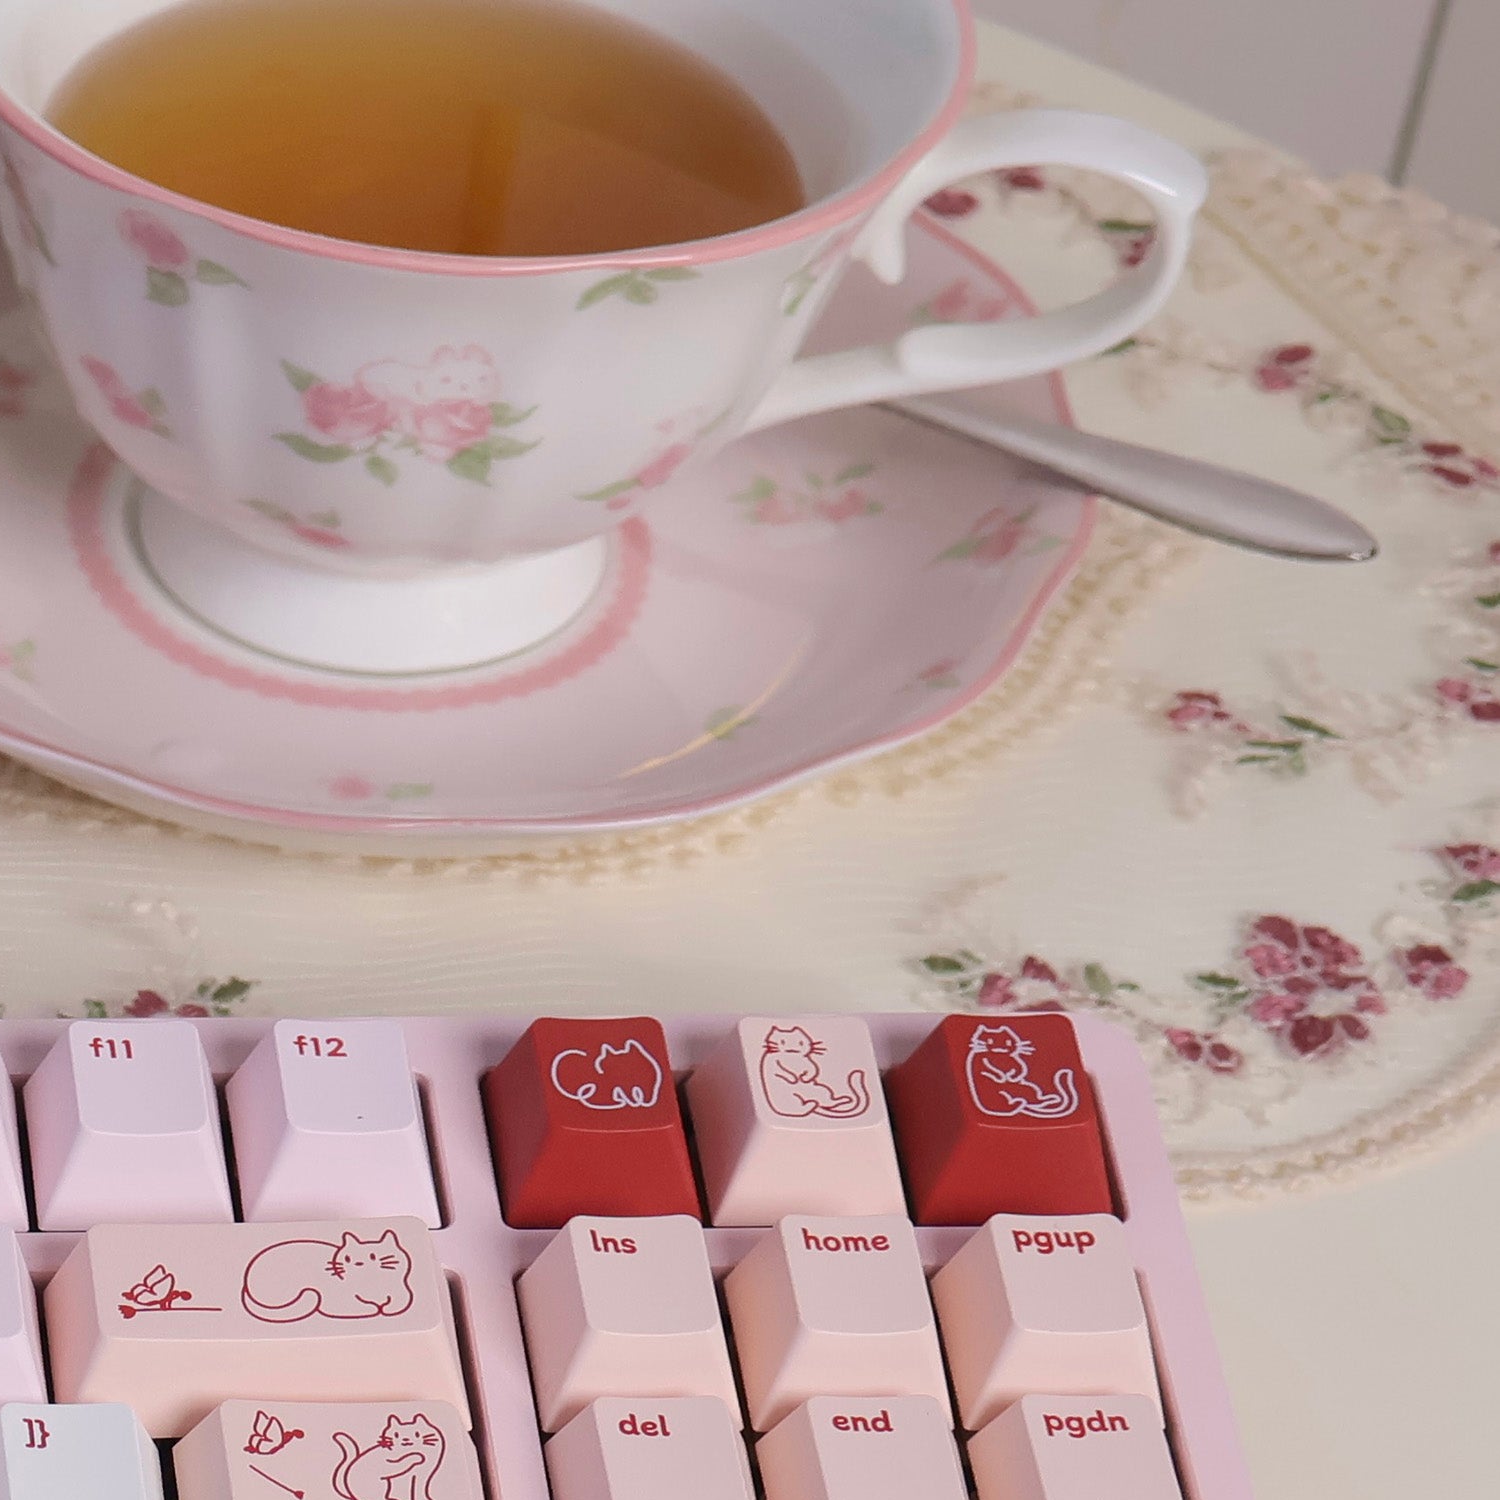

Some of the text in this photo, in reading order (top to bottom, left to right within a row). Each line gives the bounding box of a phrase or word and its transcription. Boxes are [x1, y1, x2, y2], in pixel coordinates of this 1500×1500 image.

[88, 1036, 134, 1060] f11
[292, 1034, 349, 1058] f12
[800, 1226, 891, 1253] home
[1010, 1228, 1096, 1256] pgup
[617, 1412, 672, 1438] del
[831, 1408, 895, 1434] end
[1041, 1408, 1131, 1440] pgdn
